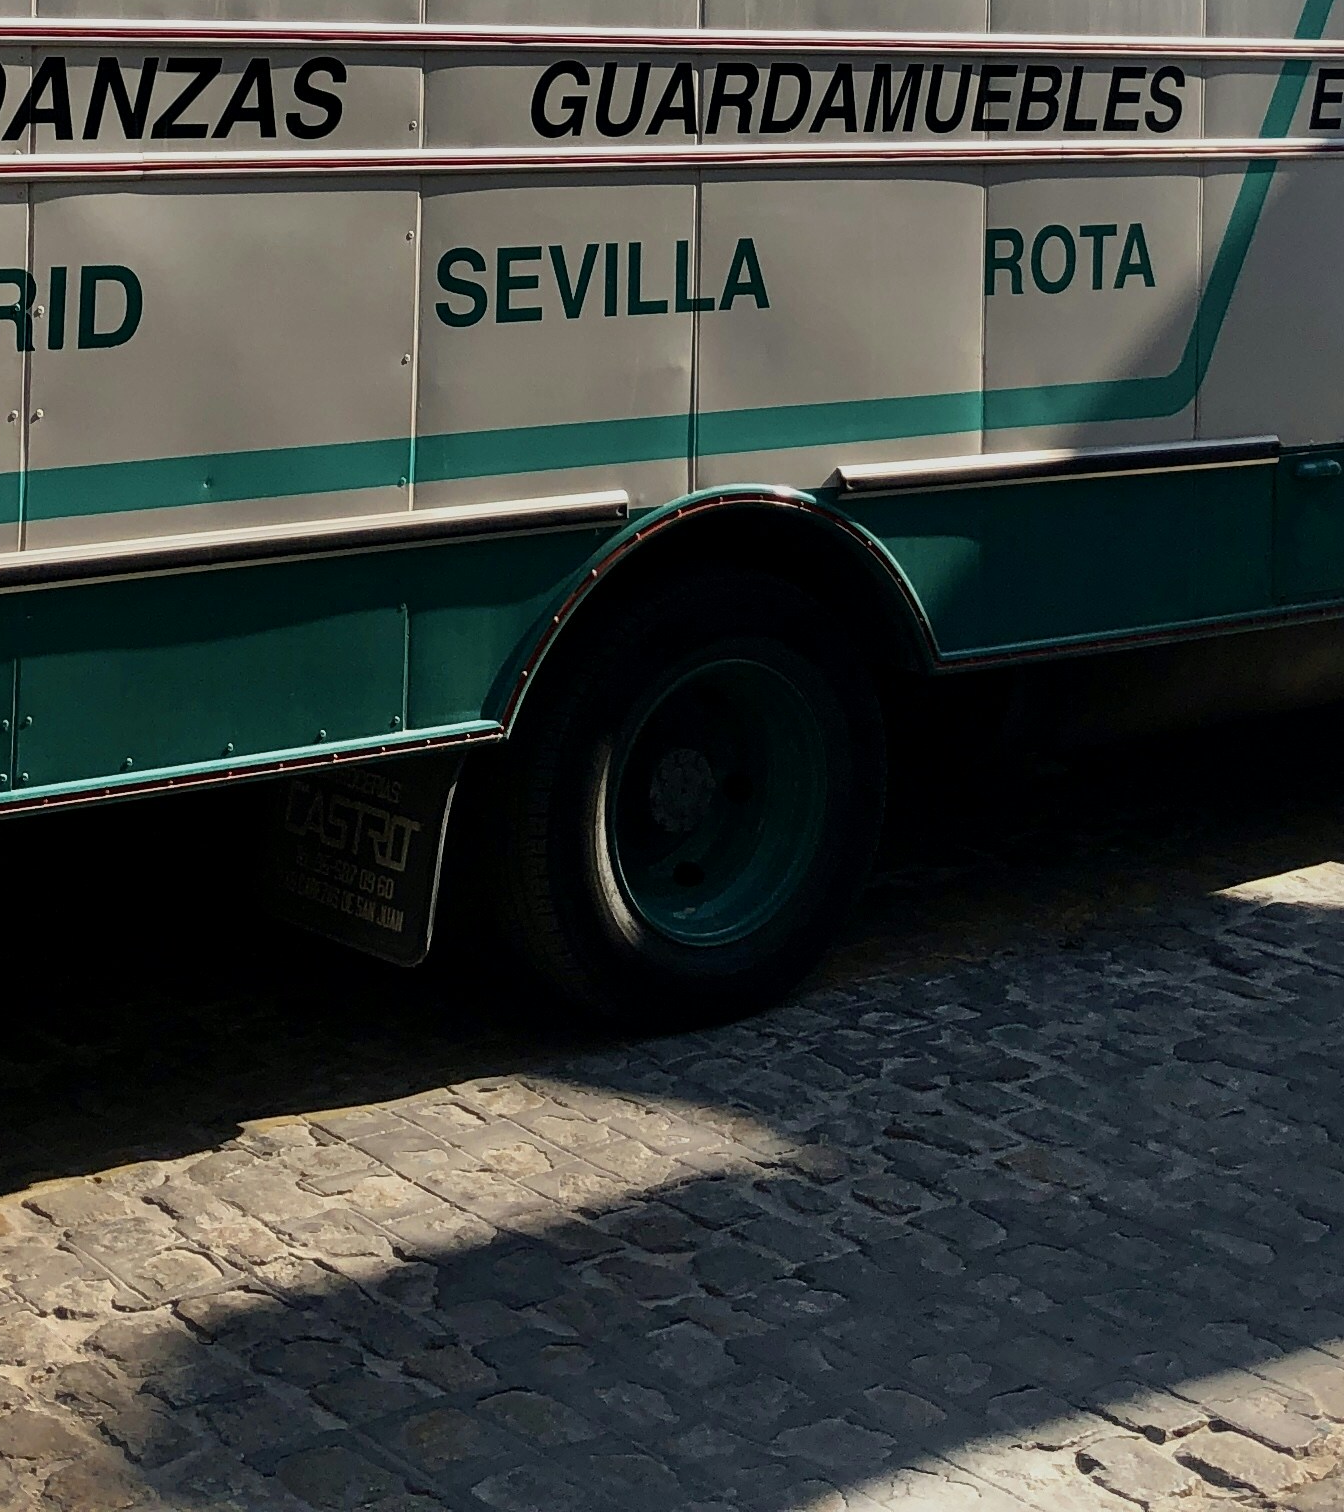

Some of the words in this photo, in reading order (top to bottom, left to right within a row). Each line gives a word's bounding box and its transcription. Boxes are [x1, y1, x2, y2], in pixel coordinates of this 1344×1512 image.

[530, 60, 1186, 139] GUARDAMUEBLES
[435, 237, 770, 328] SEVILLA
[985, 223, 1156, 296] ROTA
